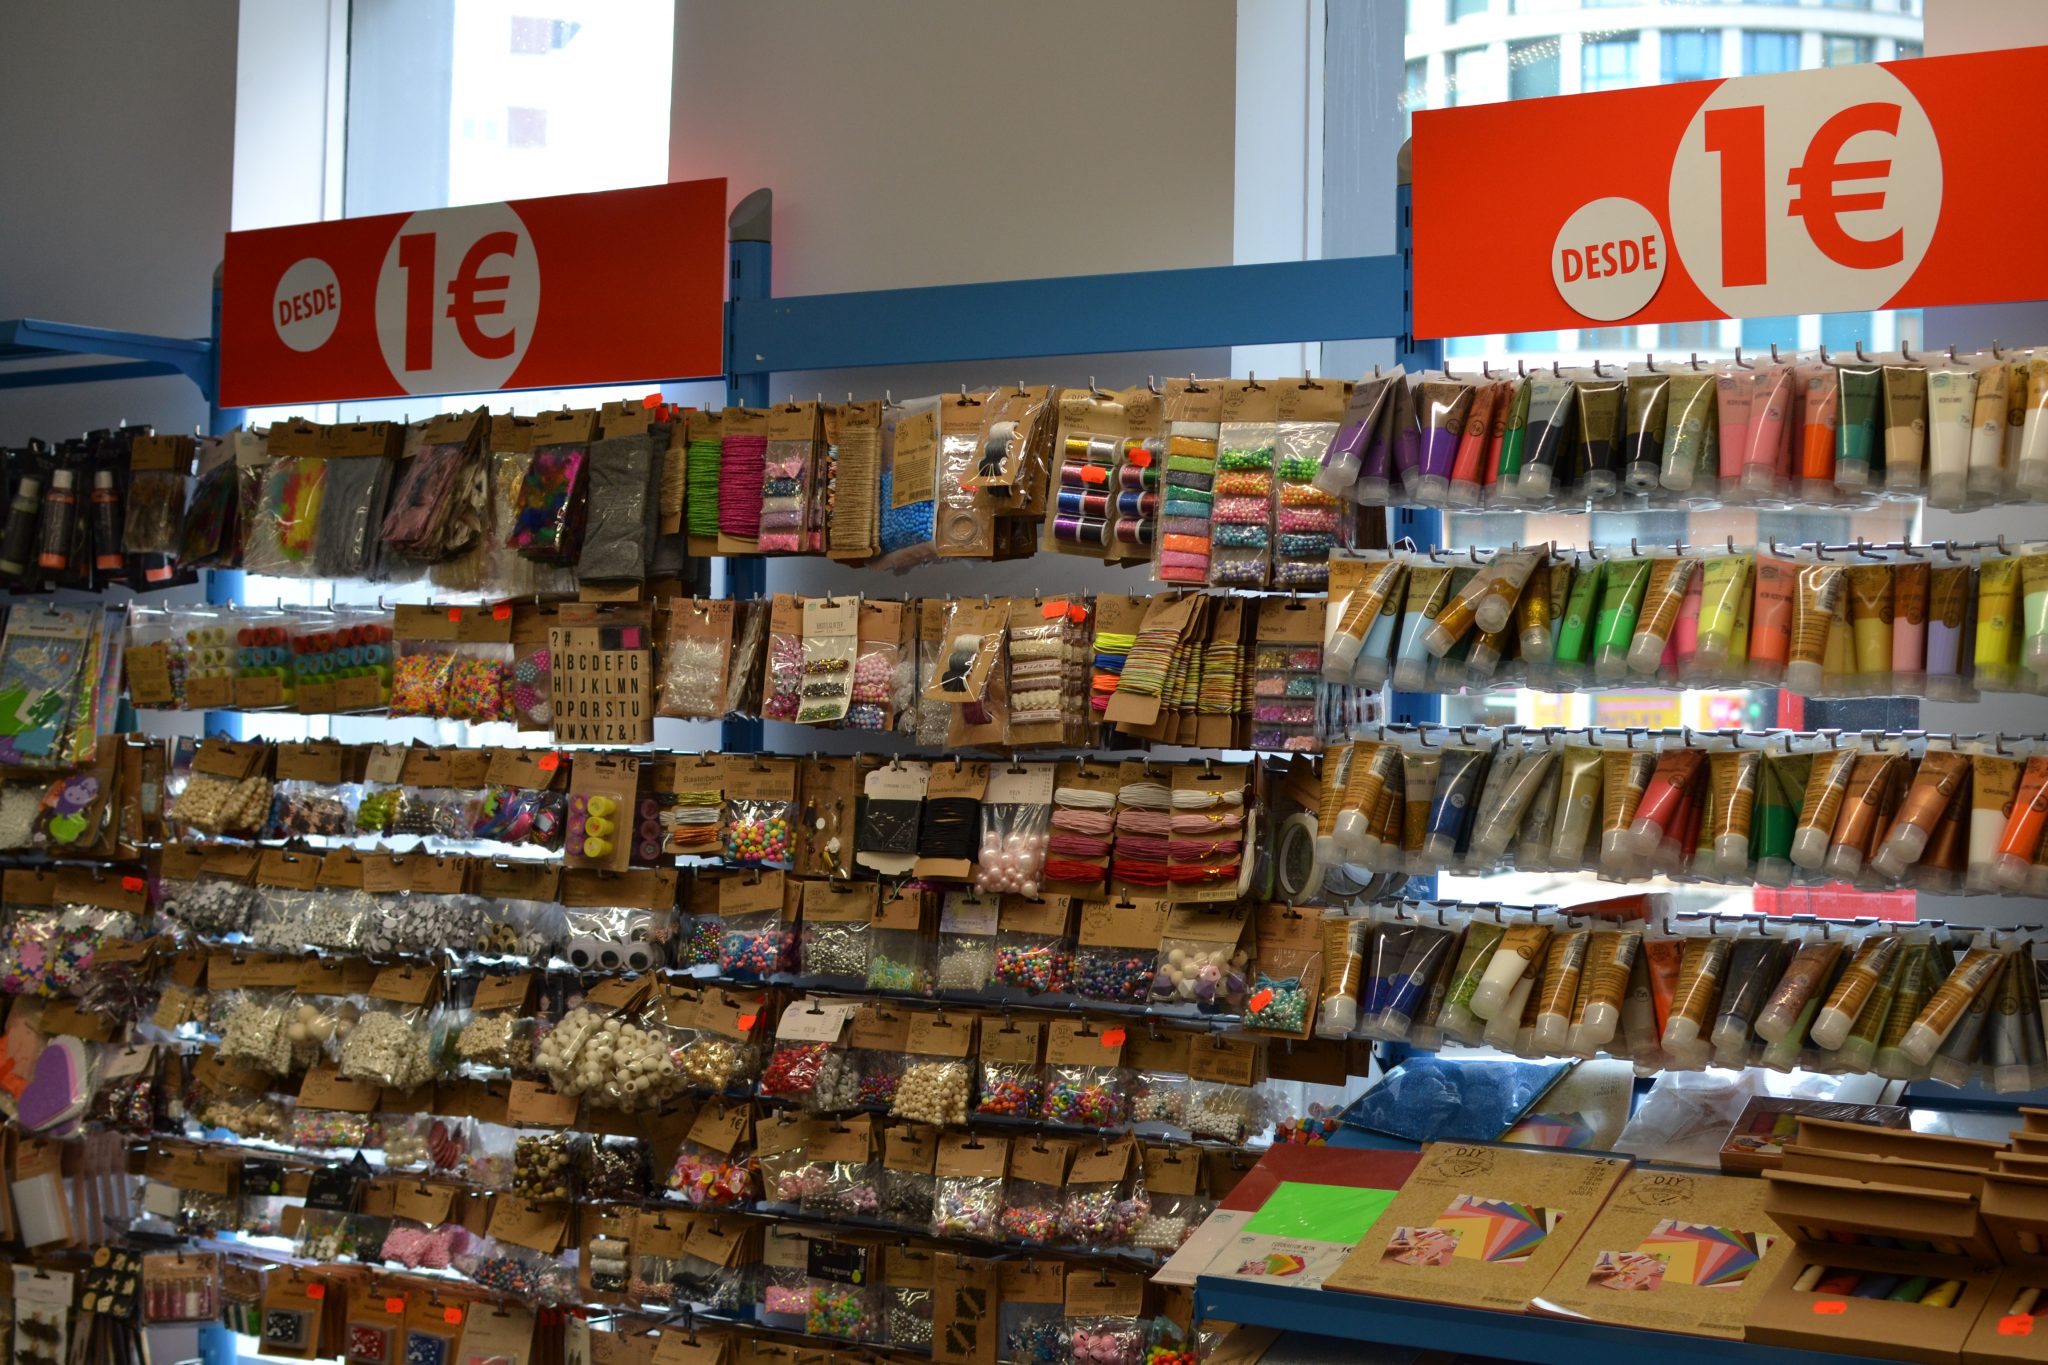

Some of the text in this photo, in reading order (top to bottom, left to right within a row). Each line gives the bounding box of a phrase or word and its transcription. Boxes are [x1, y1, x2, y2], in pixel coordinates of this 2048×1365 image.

[1560, 101, 1904, 288] DESDE 1€
[278, 231, 518, 372] DESDE 1€
[1456, 1148, 1483, 1157] DIY
[1654, 1176, 1685, 1186] DIY
